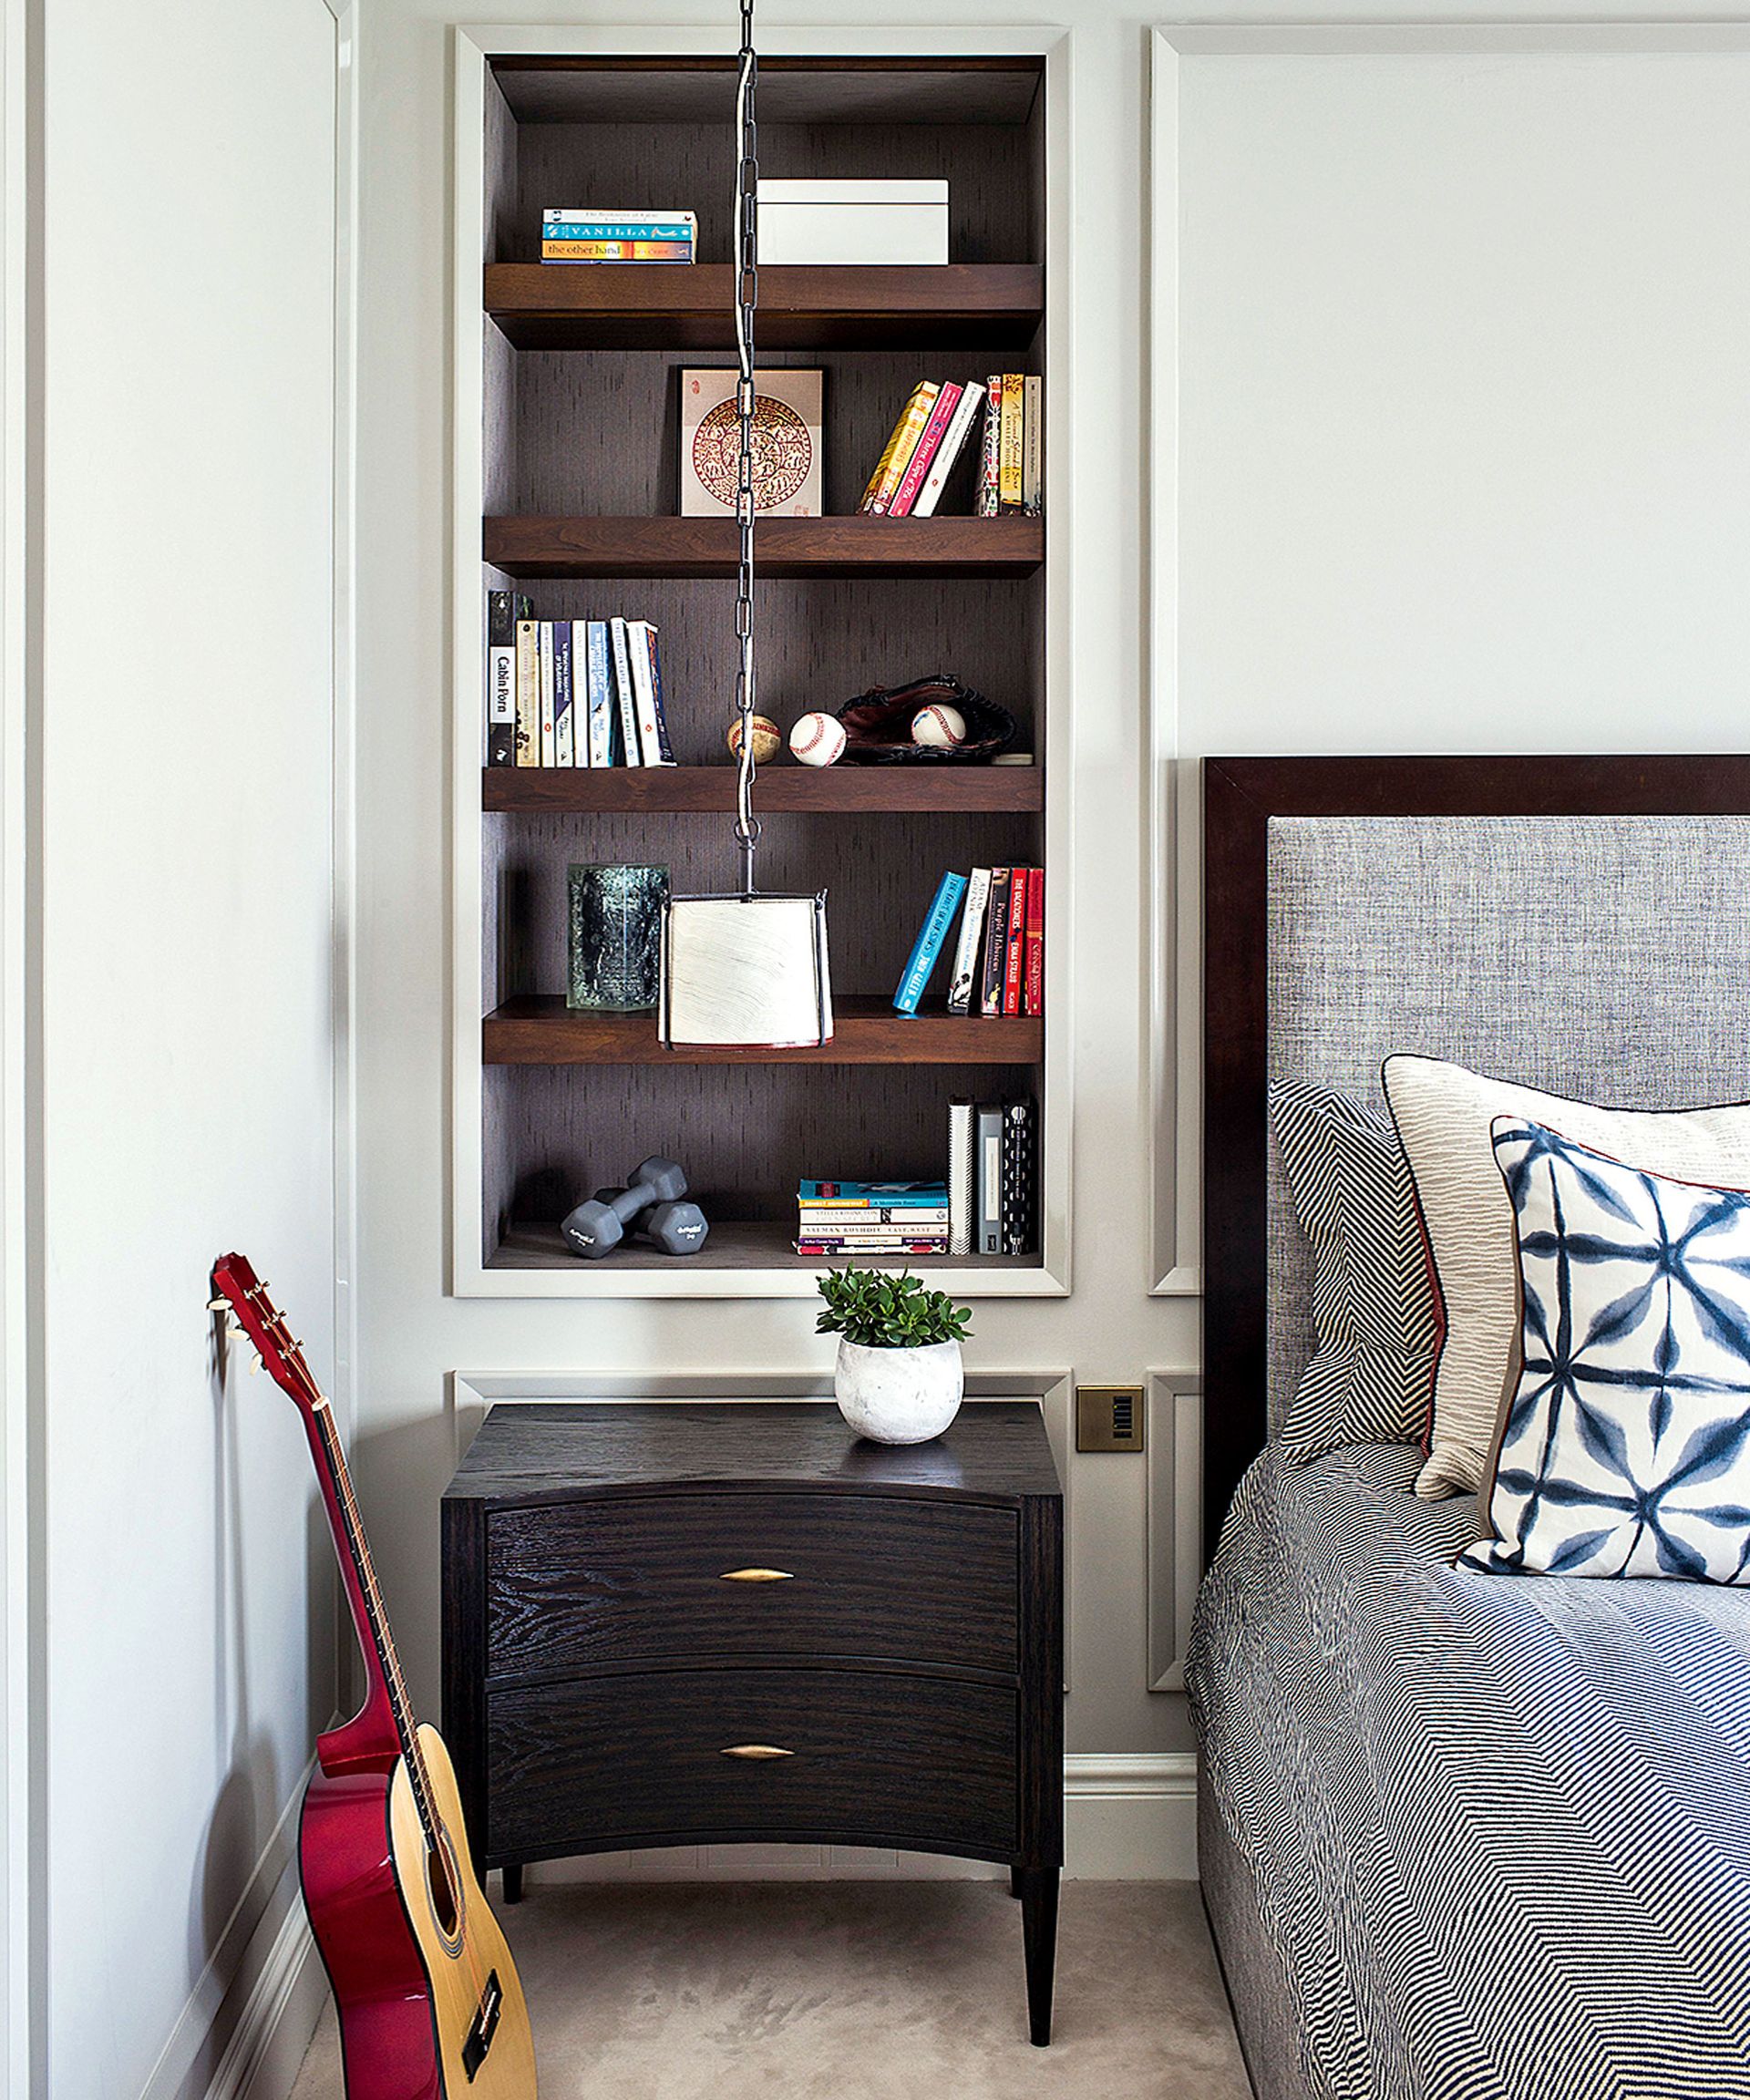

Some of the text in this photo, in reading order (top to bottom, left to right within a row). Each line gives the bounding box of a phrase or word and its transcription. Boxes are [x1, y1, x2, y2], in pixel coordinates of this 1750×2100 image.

[571, 227, 647, 236] VANILLA
[548, 244, 621, 255] the other hand
[1012, 410, 1021, 438] Thousand
[902, 435, 936, 500] Three Cups of Tea
[1010, 439, 1021, 468] Splendid
[1012, 471, 1021, 489] Suns
[497, 656, 509, 712] Cabin Porn
[975, 882, 985, 910] ADAM
[1012, 879, 1024, 929] THE VACATIONERS
[992, 902, 1005, 972] Purple Hibiscus
